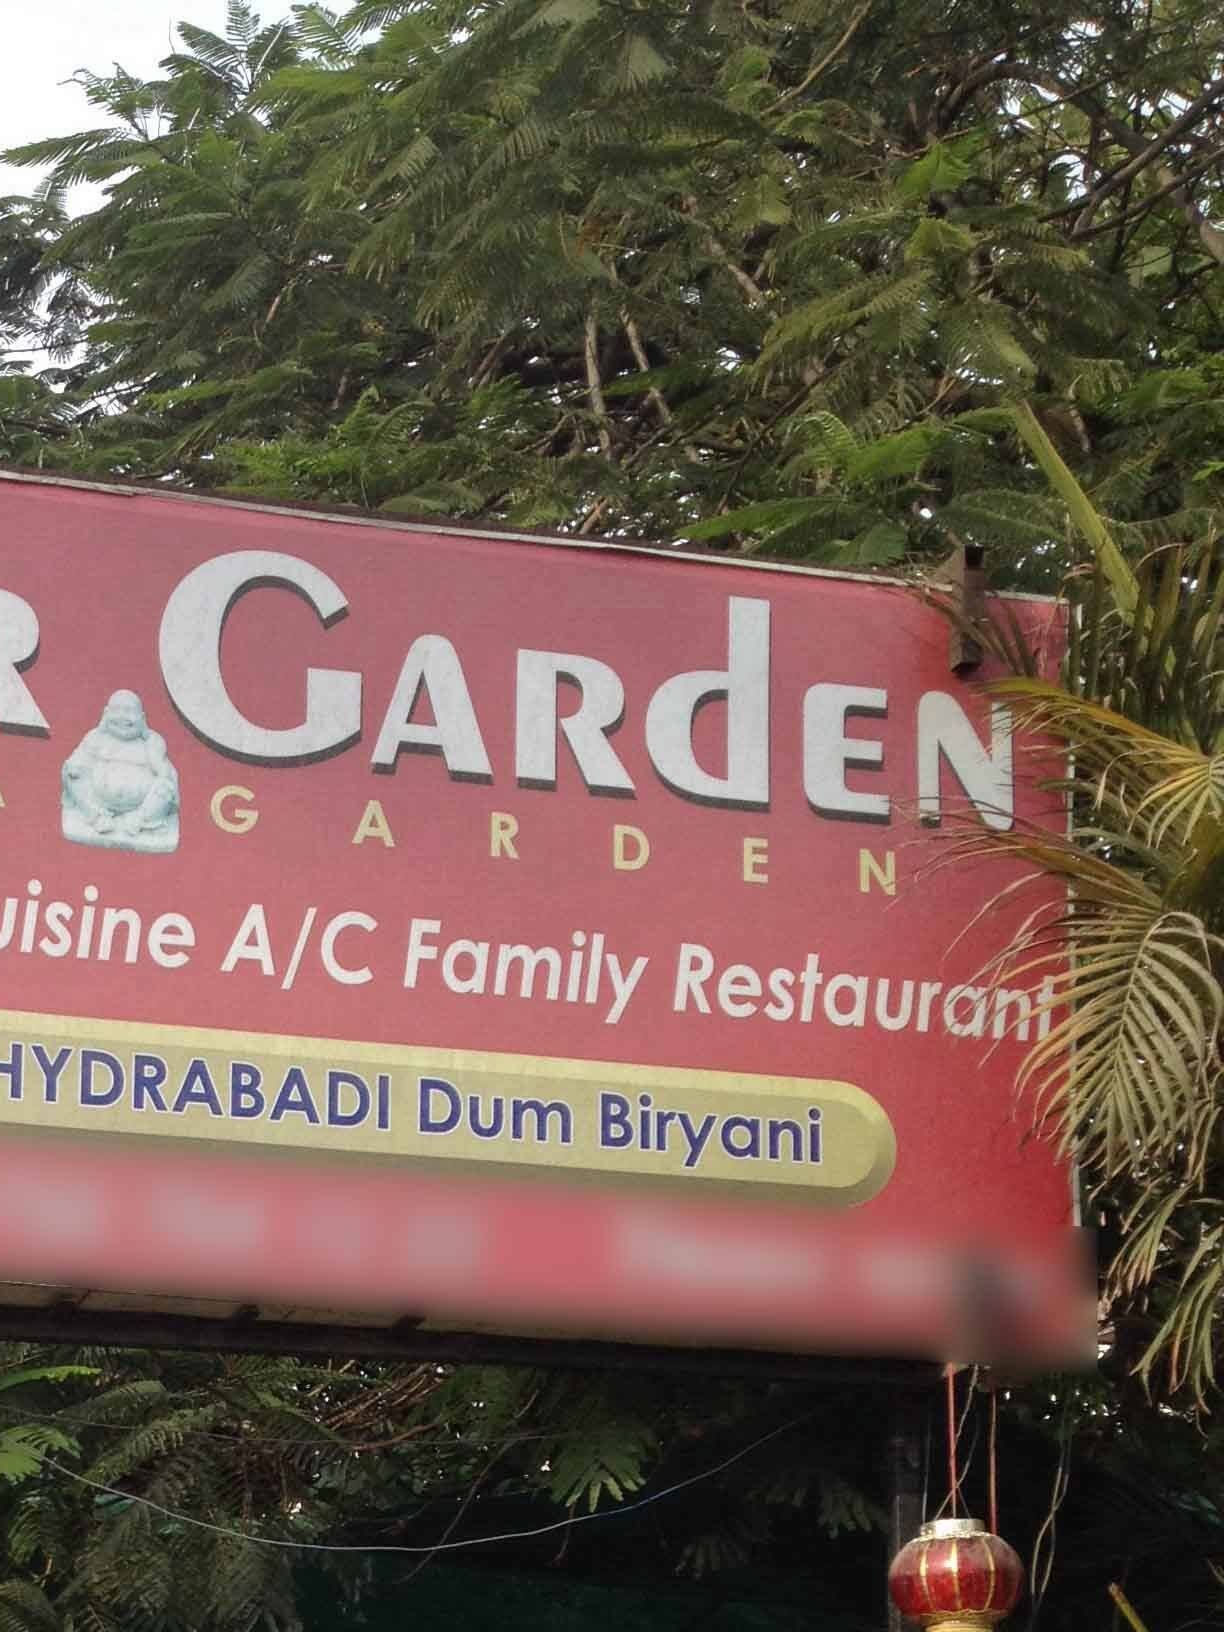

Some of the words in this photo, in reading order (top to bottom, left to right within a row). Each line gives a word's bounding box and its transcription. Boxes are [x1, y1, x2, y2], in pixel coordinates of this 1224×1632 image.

[210, 784, 898, 896] GARDEN
[221, 903, 378, 990] A/C
[404, 918, 648, 1023] Family
[673, 942, 1057, 1043] Restaurant
[417, 1078, 573, 1146] Dum
[598, 1092, 823, 1170] Biryani
